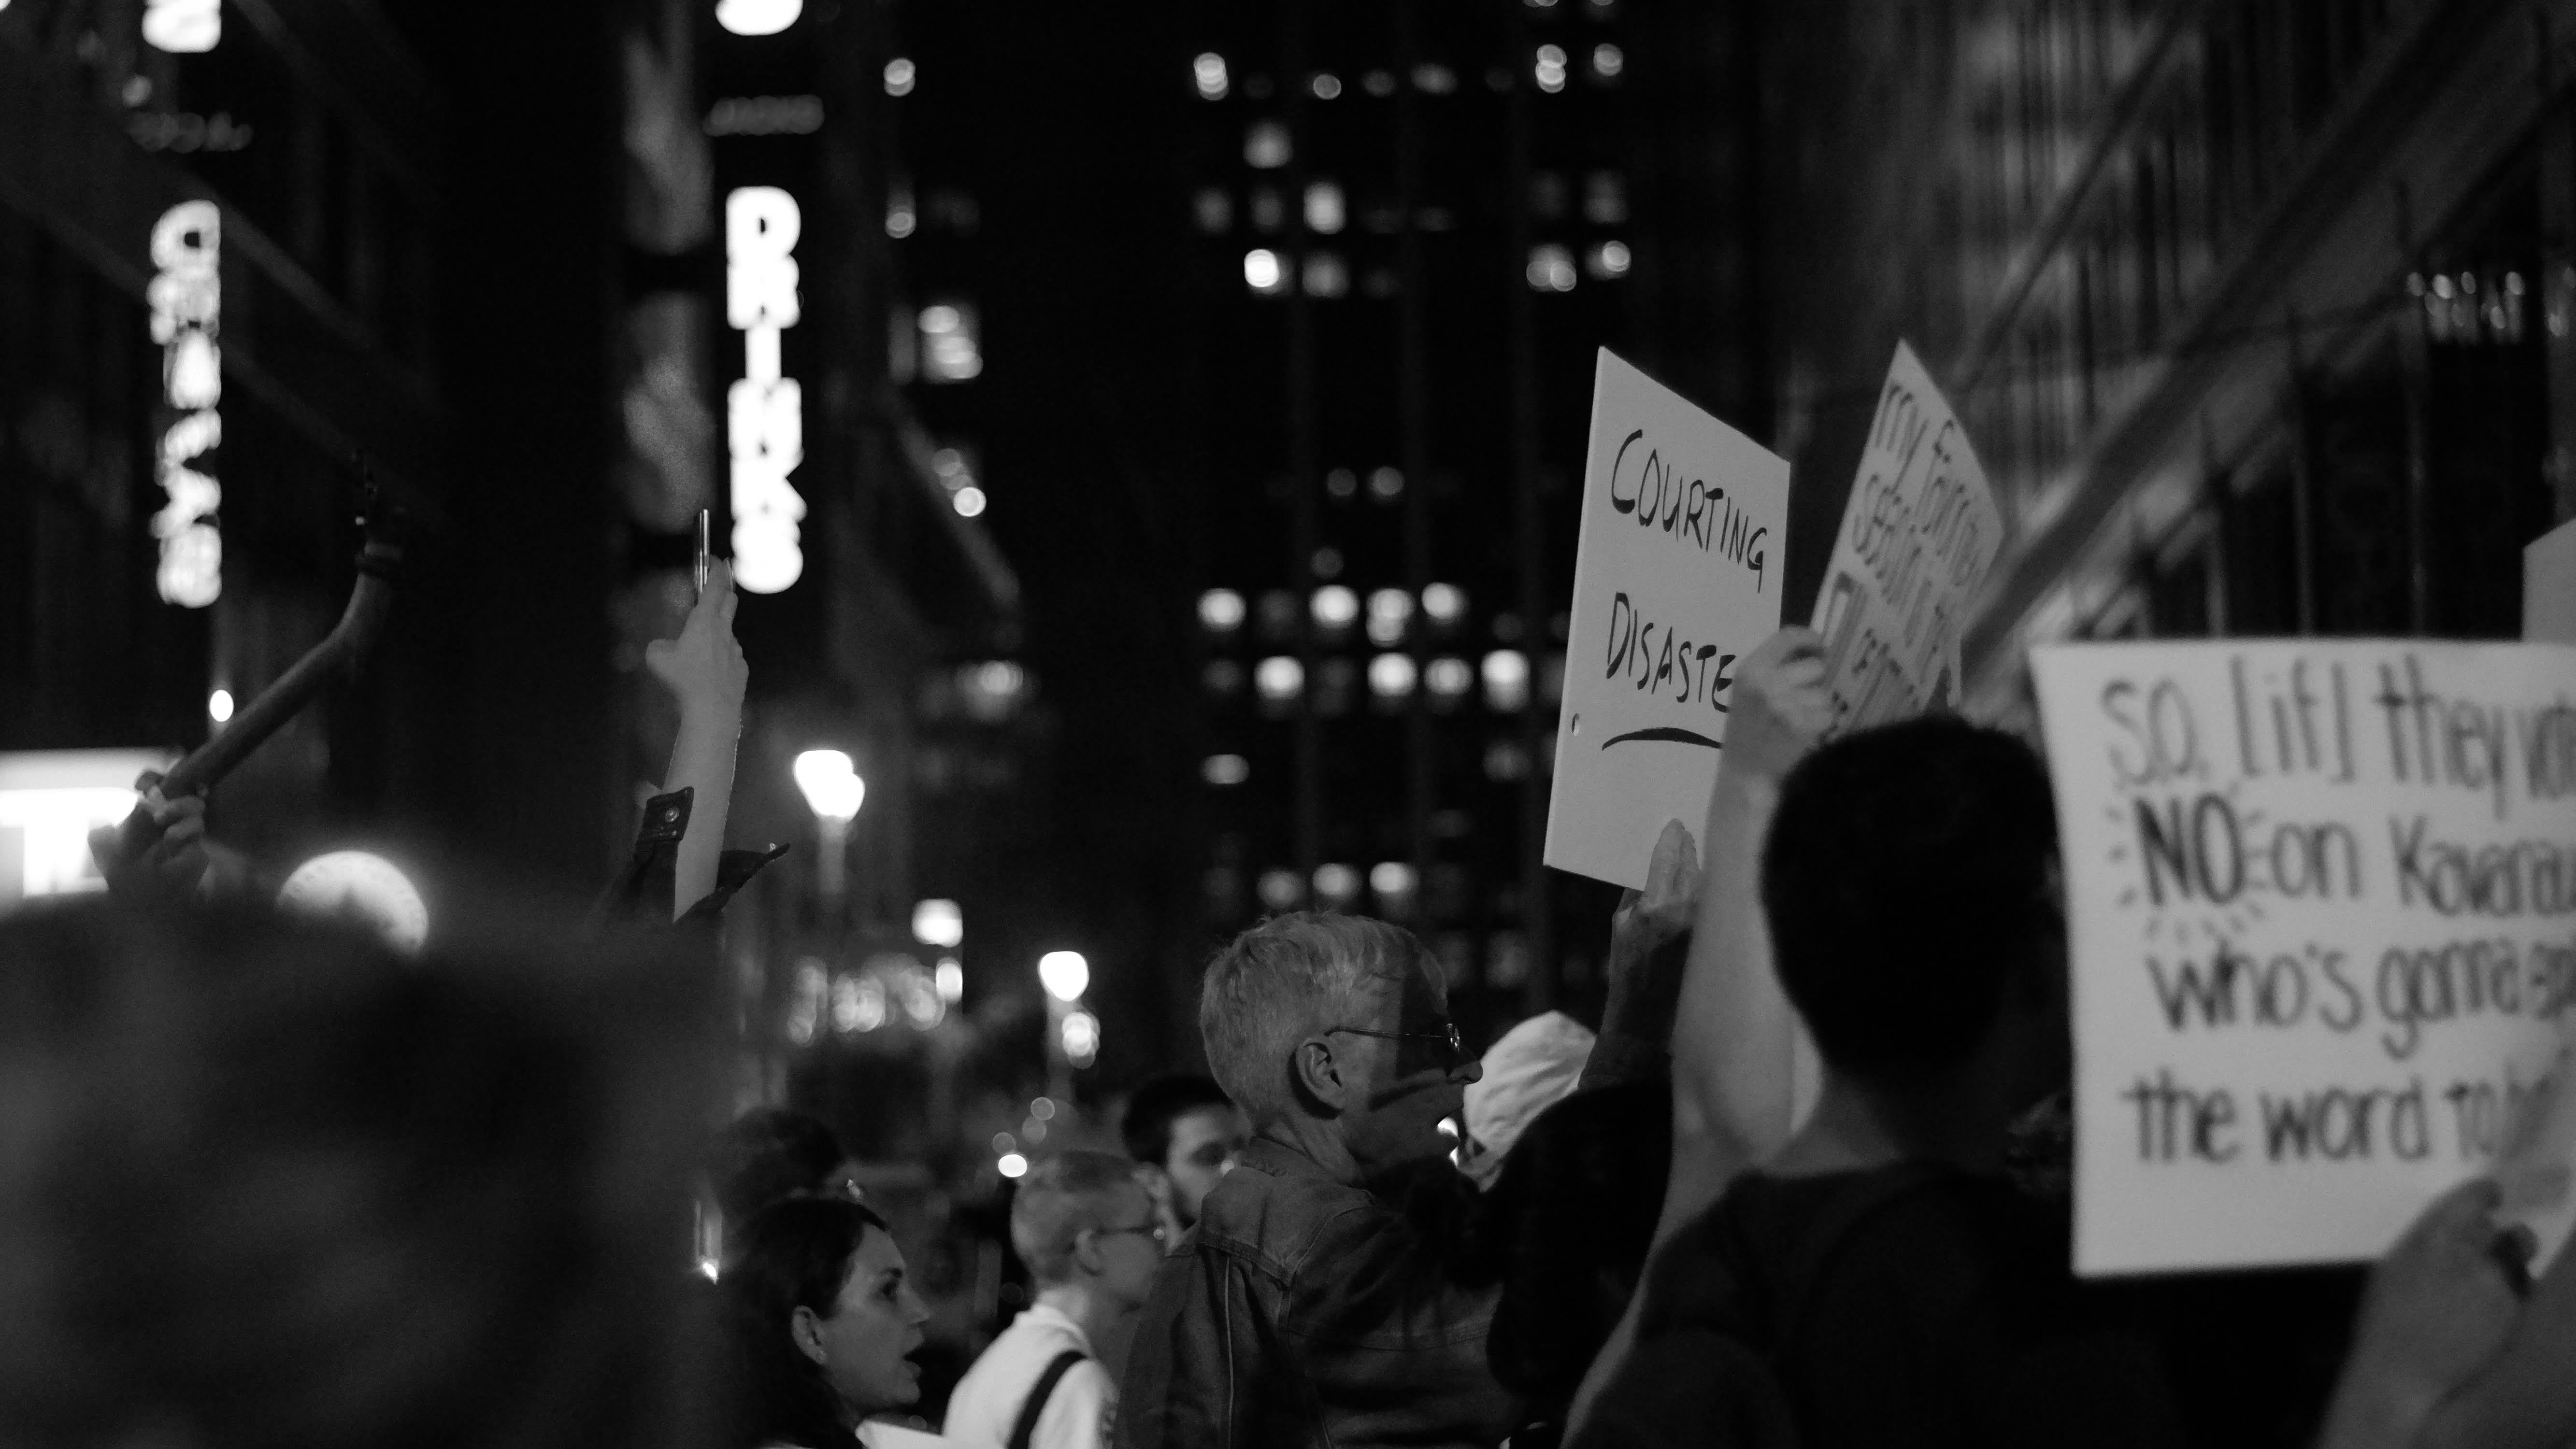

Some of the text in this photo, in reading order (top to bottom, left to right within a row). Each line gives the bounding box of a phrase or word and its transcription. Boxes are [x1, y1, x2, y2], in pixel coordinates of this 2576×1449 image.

[1612, 429, 1767, 594] COURTING
[1606, 592, 1736, 713] DISASTE
[2372, 652, 2508, 822] they
[2134, 792, 2246, 906] NO
[2272, 821, 2361, 899] on
[2121, 1065, 2243, 1164] the
[2258, 1073, 2431, 1163] word
